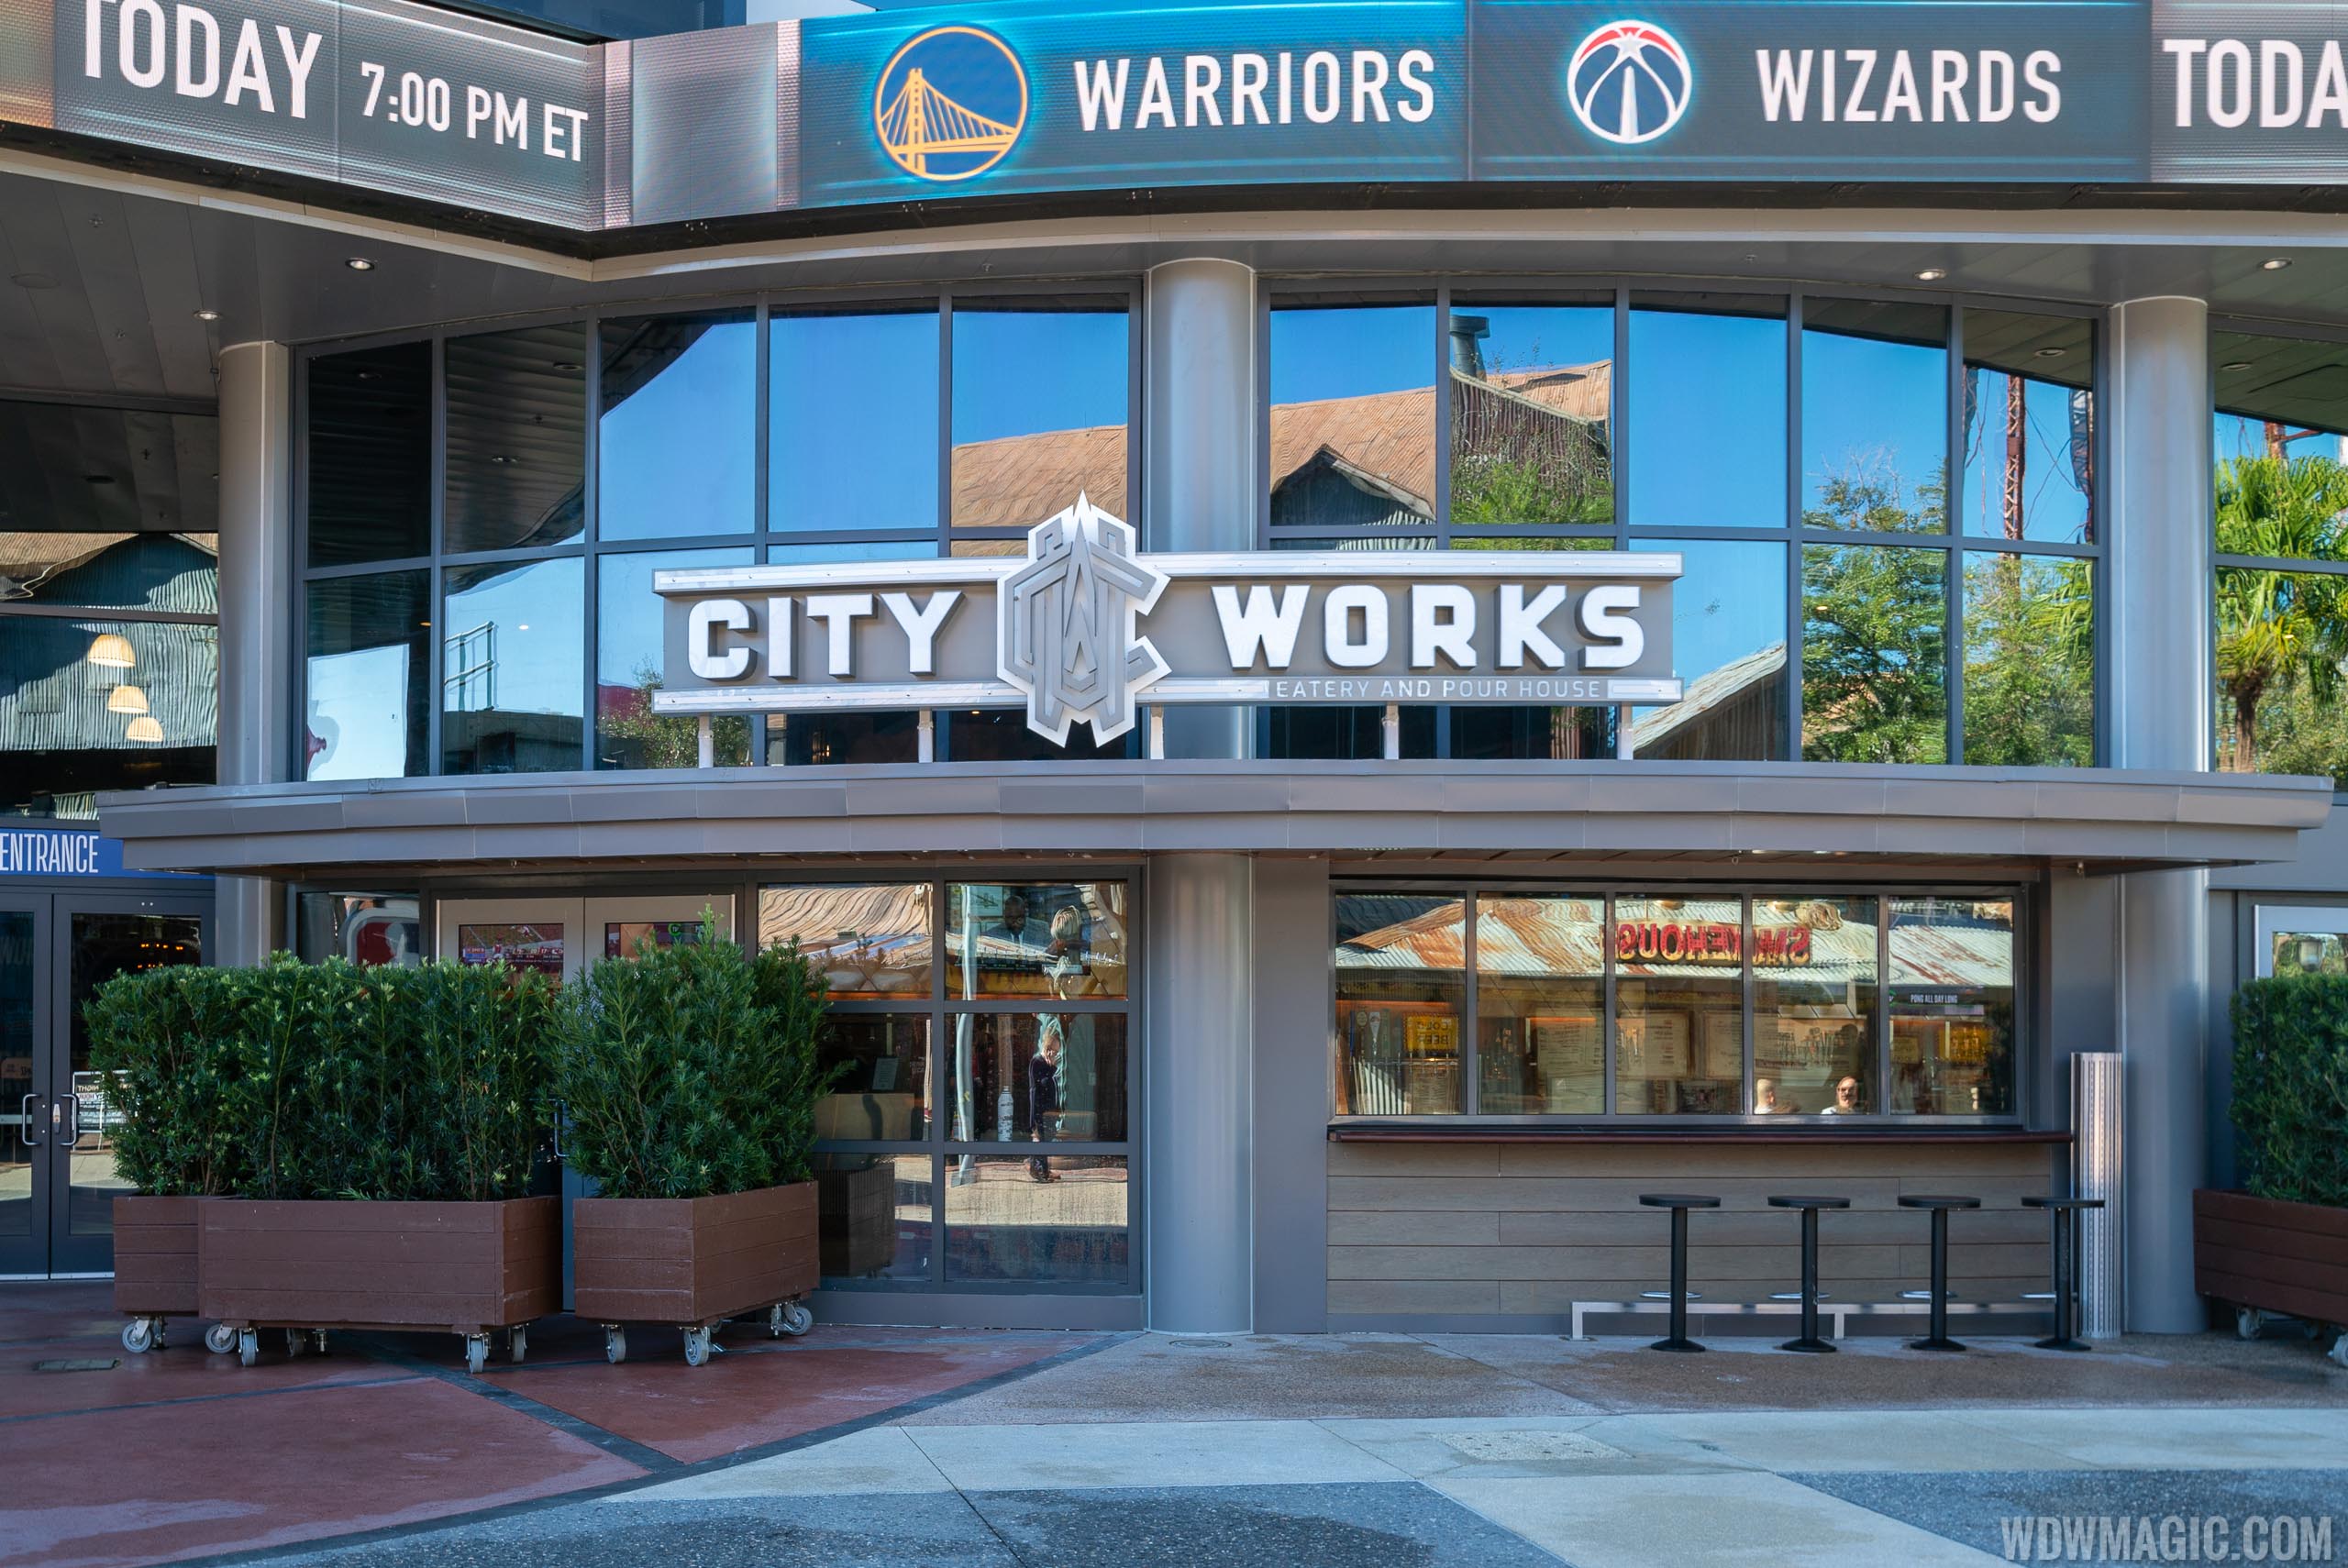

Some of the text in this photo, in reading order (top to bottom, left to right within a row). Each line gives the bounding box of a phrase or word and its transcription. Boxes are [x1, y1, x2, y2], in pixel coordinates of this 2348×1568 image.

[83, 0, 589, 161] TODAY 7:00 PM ET
[1073, 50, 1435, 132] WARRIORS
[1755, 50, 2062, 123] WIZARDS
[688, 583, 1645, 680] CITY WORKS
[1277, 679, 1601, 699] EATERY AND POUR HOUSE
[0, 833, 99, 874] ENTRANCE
